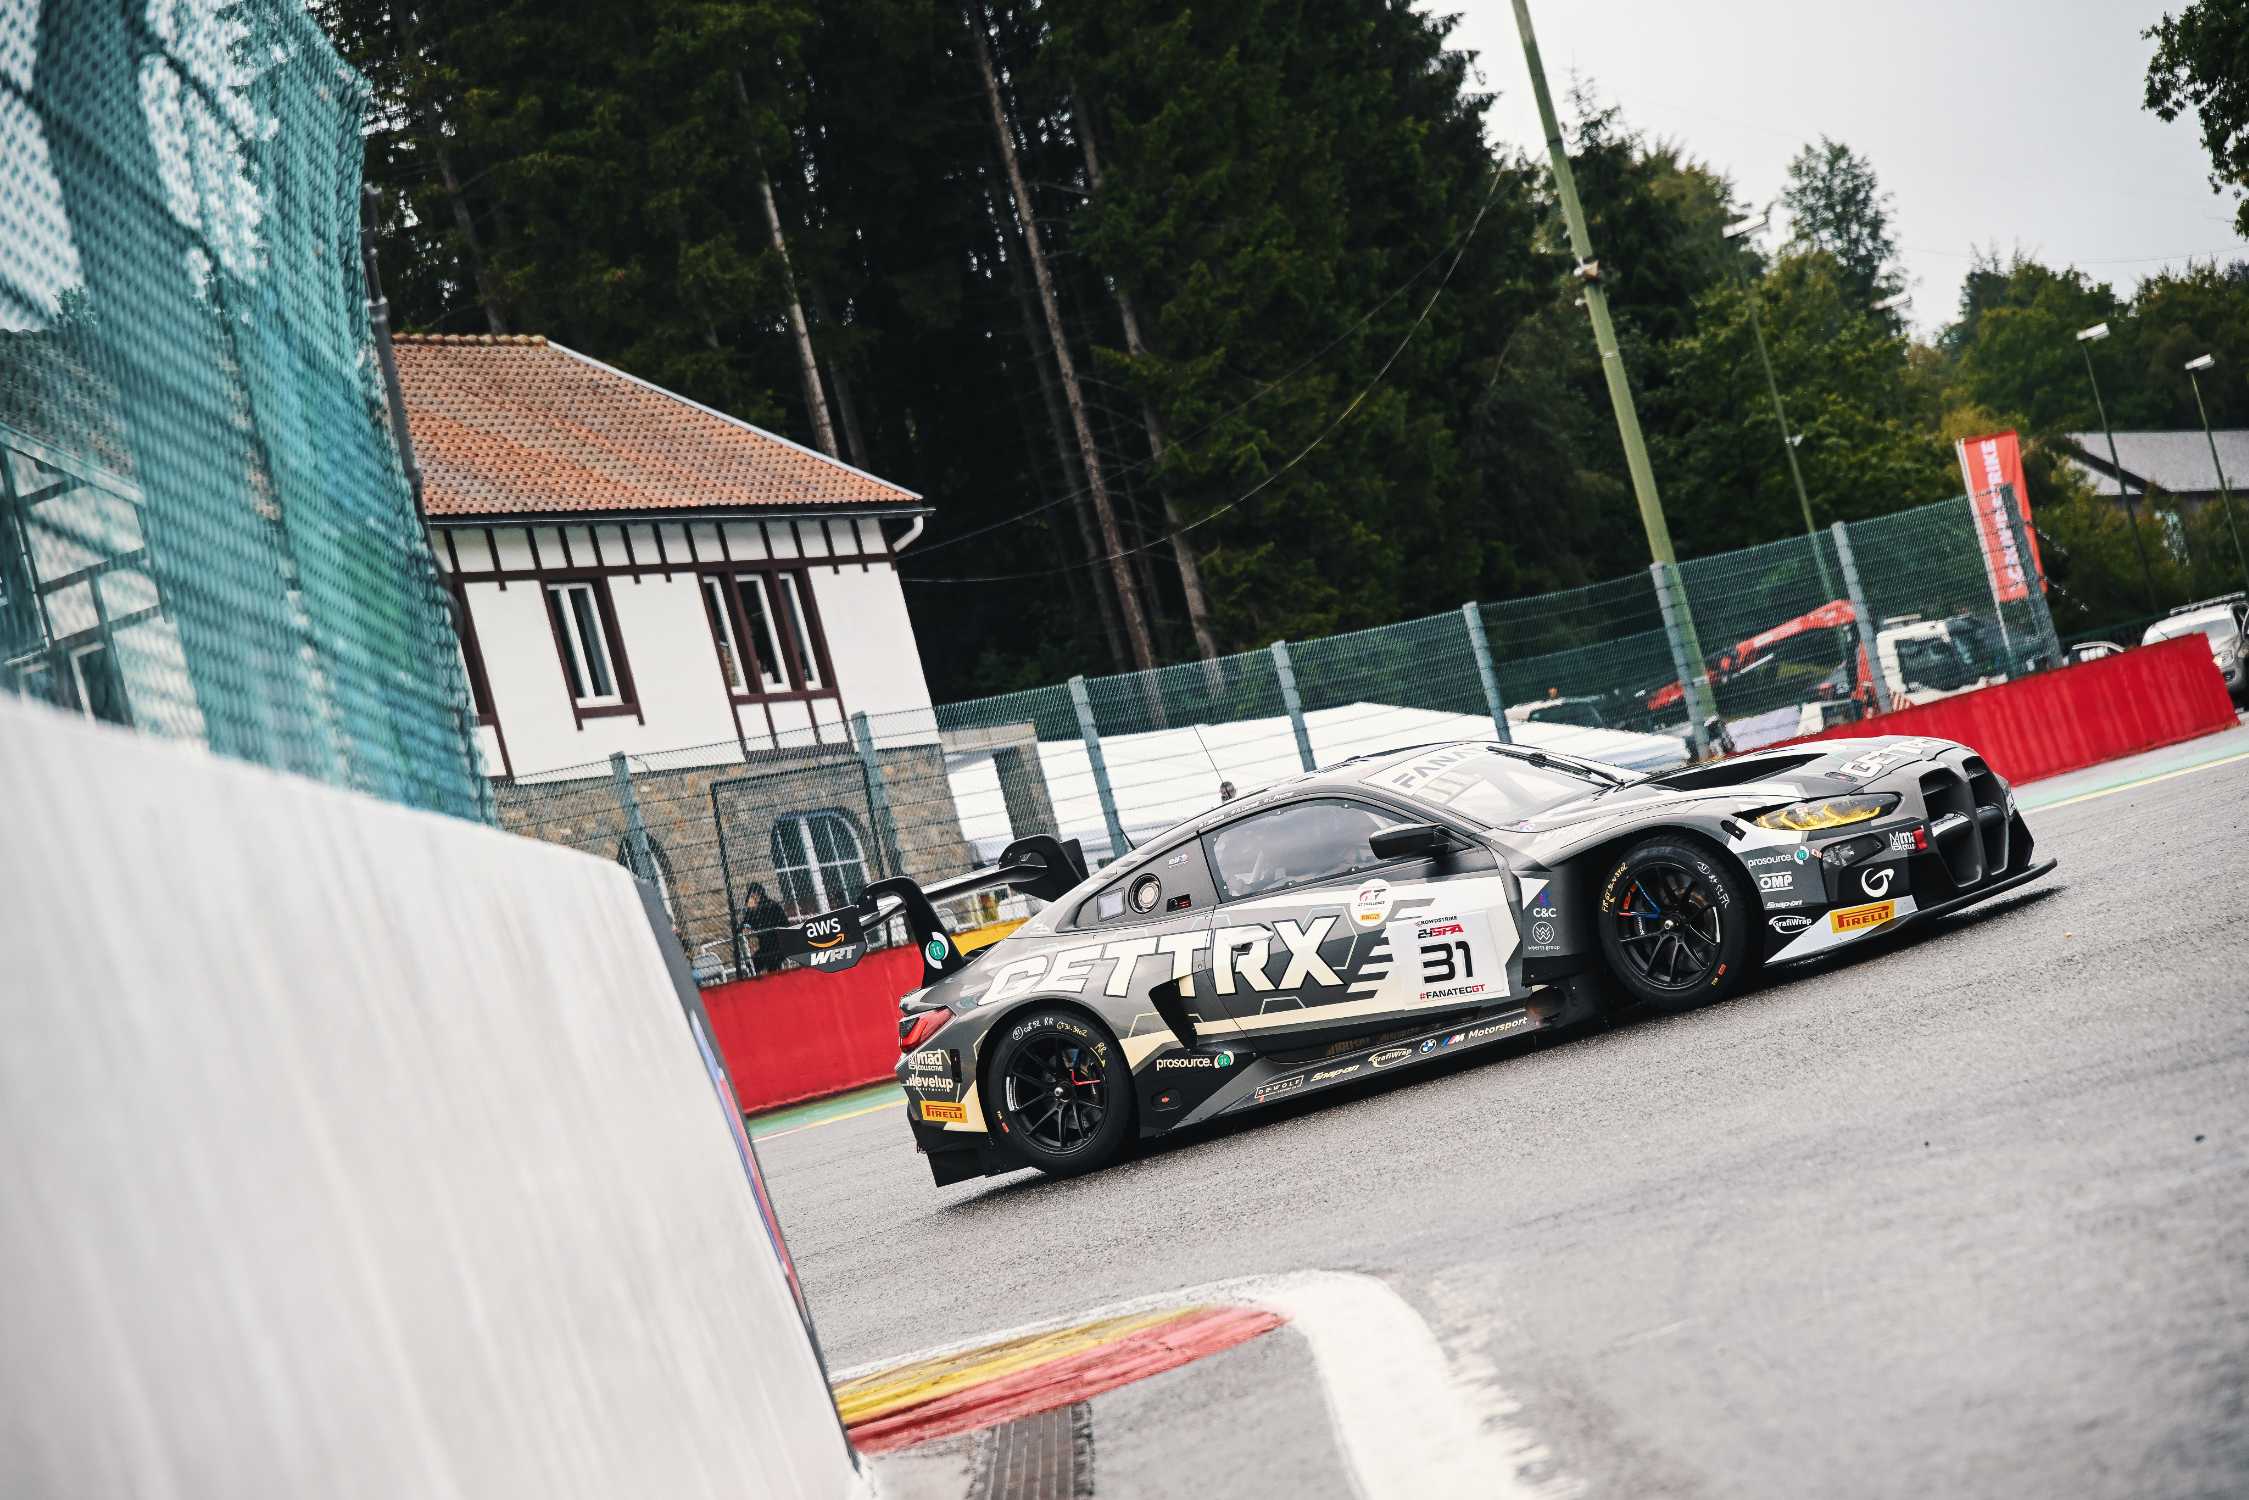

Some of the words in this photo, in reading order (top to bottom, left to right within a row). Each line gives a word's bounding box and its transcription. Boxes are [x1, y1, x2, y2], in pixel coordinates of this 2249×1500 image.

[1760, 875, 1793, 889] OMP
[1533, 908, 1557, 918] C&C
[1772, 918, 1812, 928] GrafiWrap
[1837, 905, 1890, 929] PIRELLI
[805, 918, 841, 938] aws
[810, 945, 857, 966] WRT
[976, 914, 1345, 1007] GETTRX
[1420, 940, 1474, 984] 31
[1420, 984, 1486, 1000] #FANATECGT
[1468, 1016, 1528, 1039] Motorsport
[925, 1104, 963, 1119] PIRELLI
